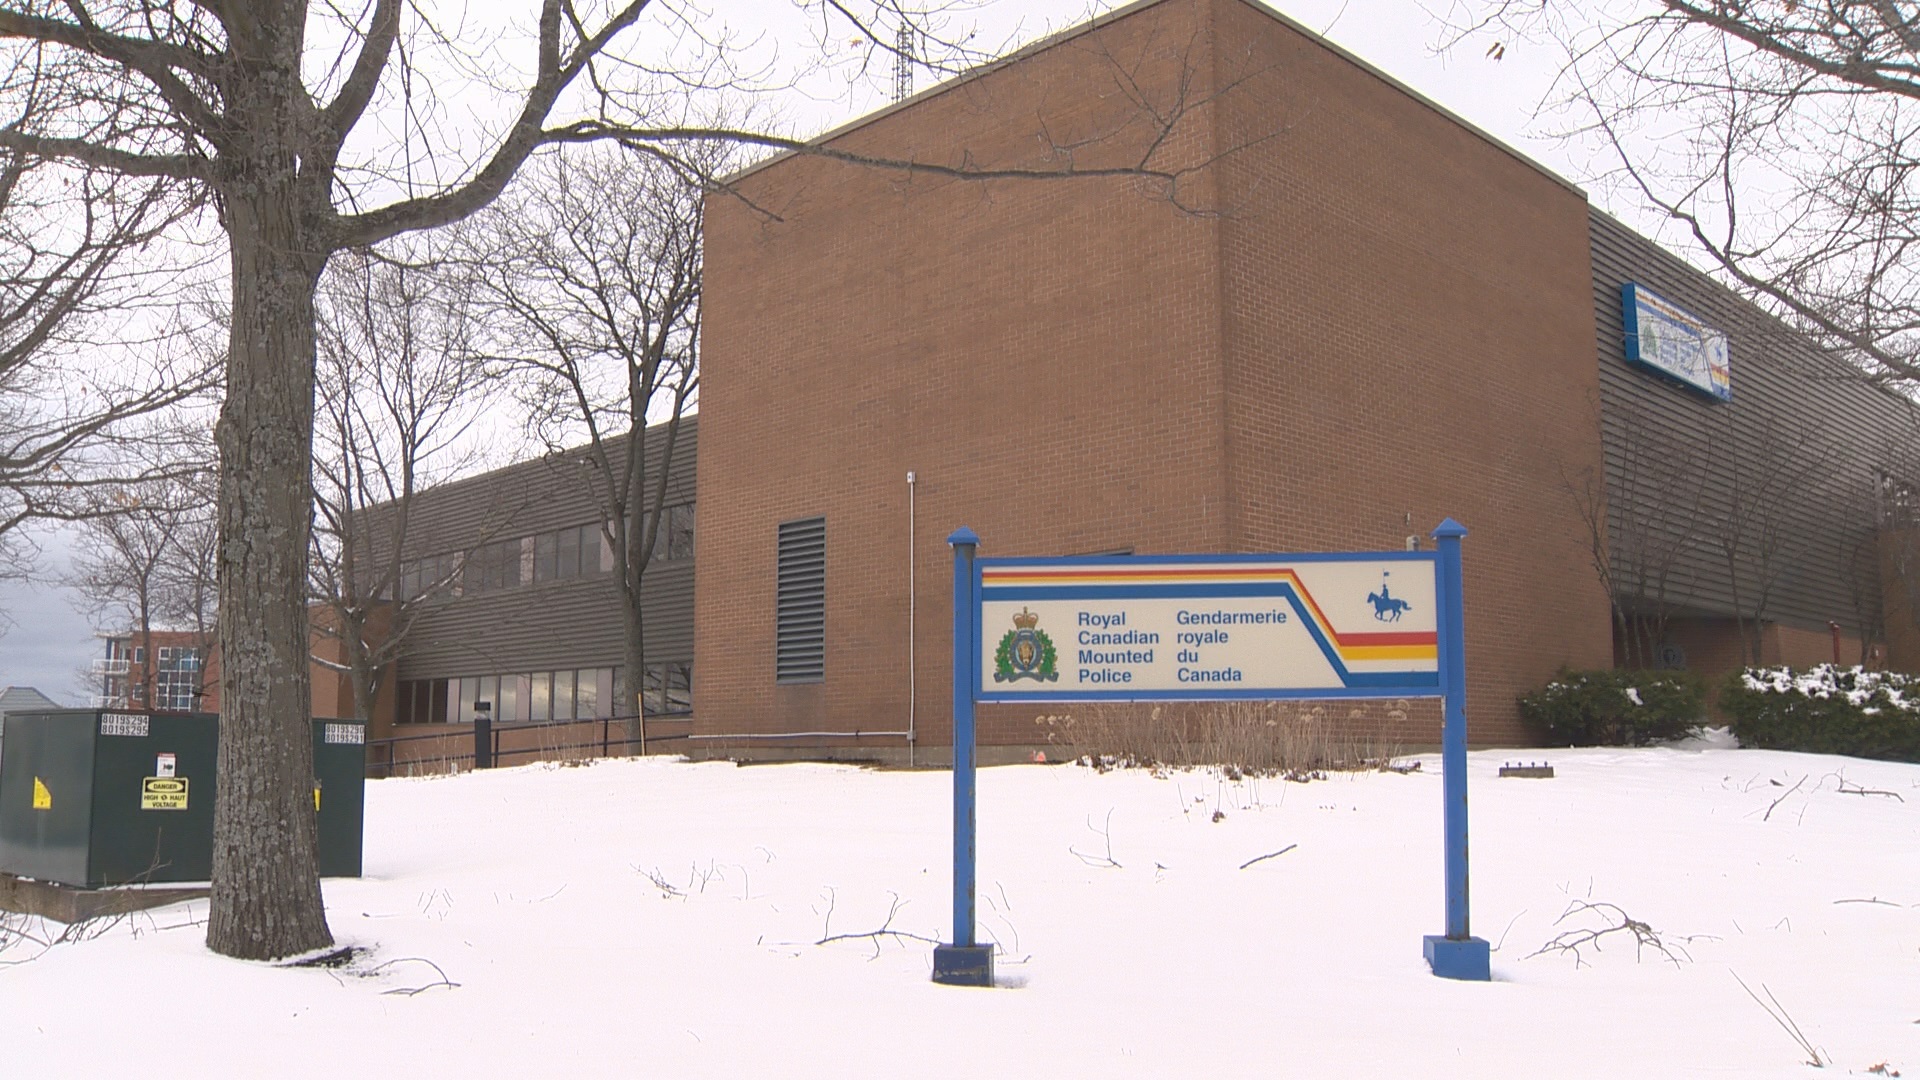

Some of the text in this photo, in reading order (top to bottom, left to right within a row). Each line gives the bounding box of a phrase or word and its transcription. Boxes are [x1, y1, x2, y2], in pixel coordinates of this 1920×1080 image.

[1079, 612, 1125, 629] Royal
[1177, 610, 1286, 625] Gendarmerie
[1079, 630, 1159, 645] Canadian
[1178, 629, 1228, 647] royale
[1079, 649, 1153, 664] Mounted
[1177, 649, 1198, 663] du
[1079, 669, 1132, 683] Police
[1178, 667, 1241, 682] Canada
[102, 715, 148, 725] 8019S294
[102, 724, 148, 735] 8019S295
